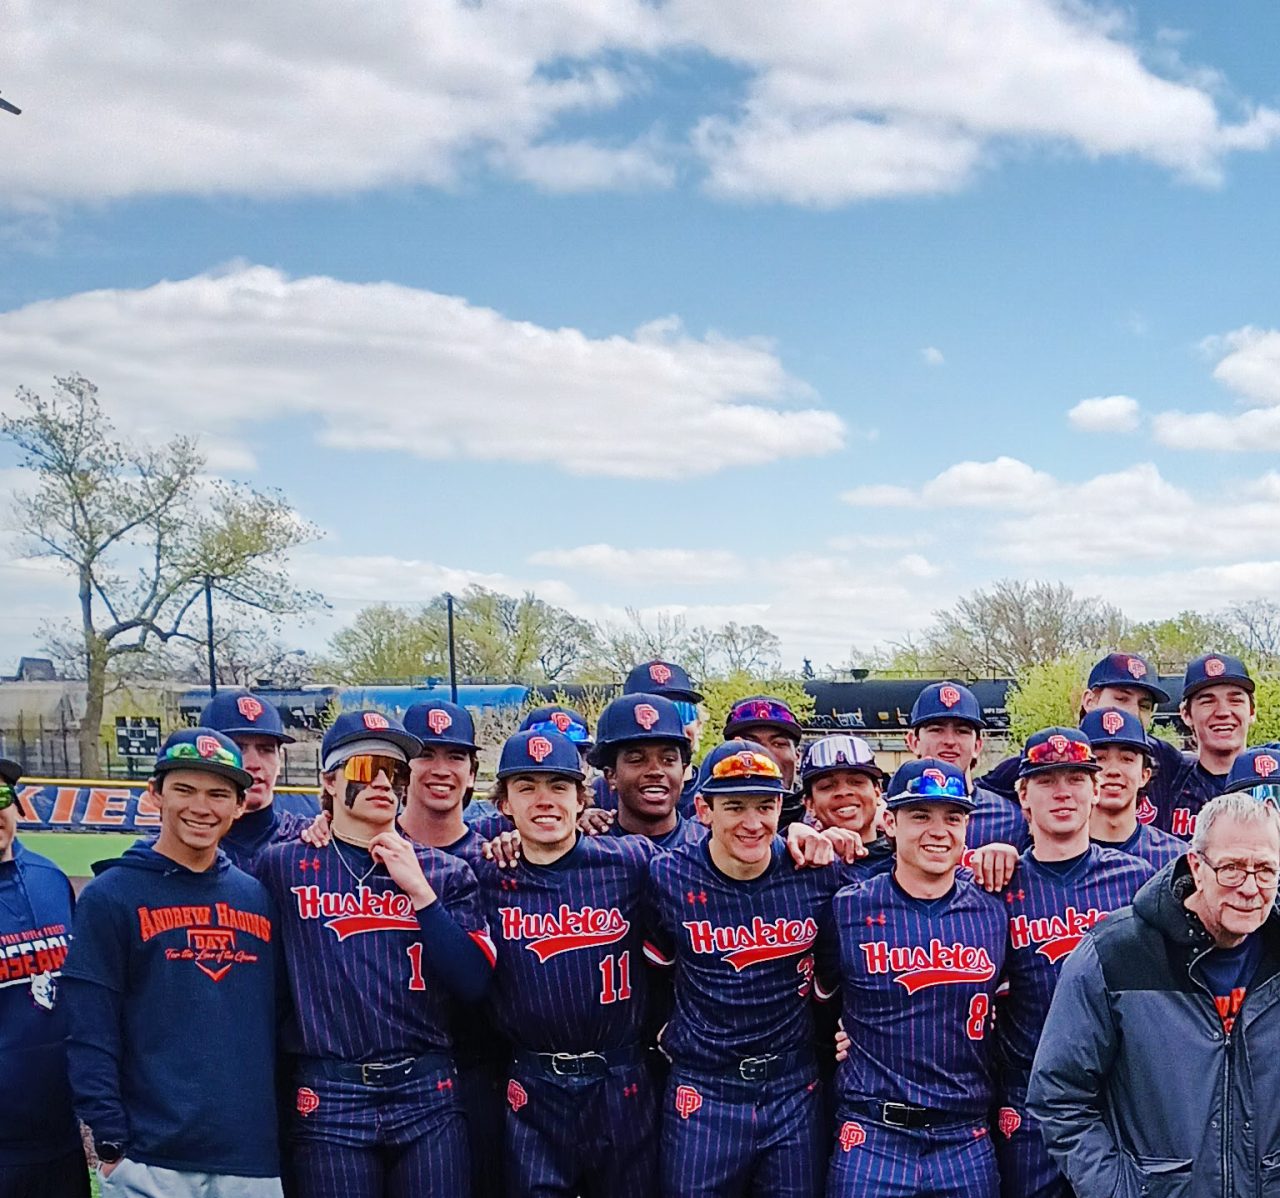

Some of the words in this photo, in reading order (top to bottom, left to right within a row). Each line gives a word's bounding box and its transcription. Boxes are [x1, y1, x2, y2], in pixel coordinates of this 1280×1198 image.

[137, 905, 211, 942] ANDREW
[498, 904, 630, 940] Huskies
[682, 916, 818, 954] Huskies
[194, 935, 228, 950] DAY
[859, 938, 995, 974] Huskies
[406, 942, 426, 991] 1
[599, 950, 632, 1004] 11
[967, 992, 989, 1041] 8
